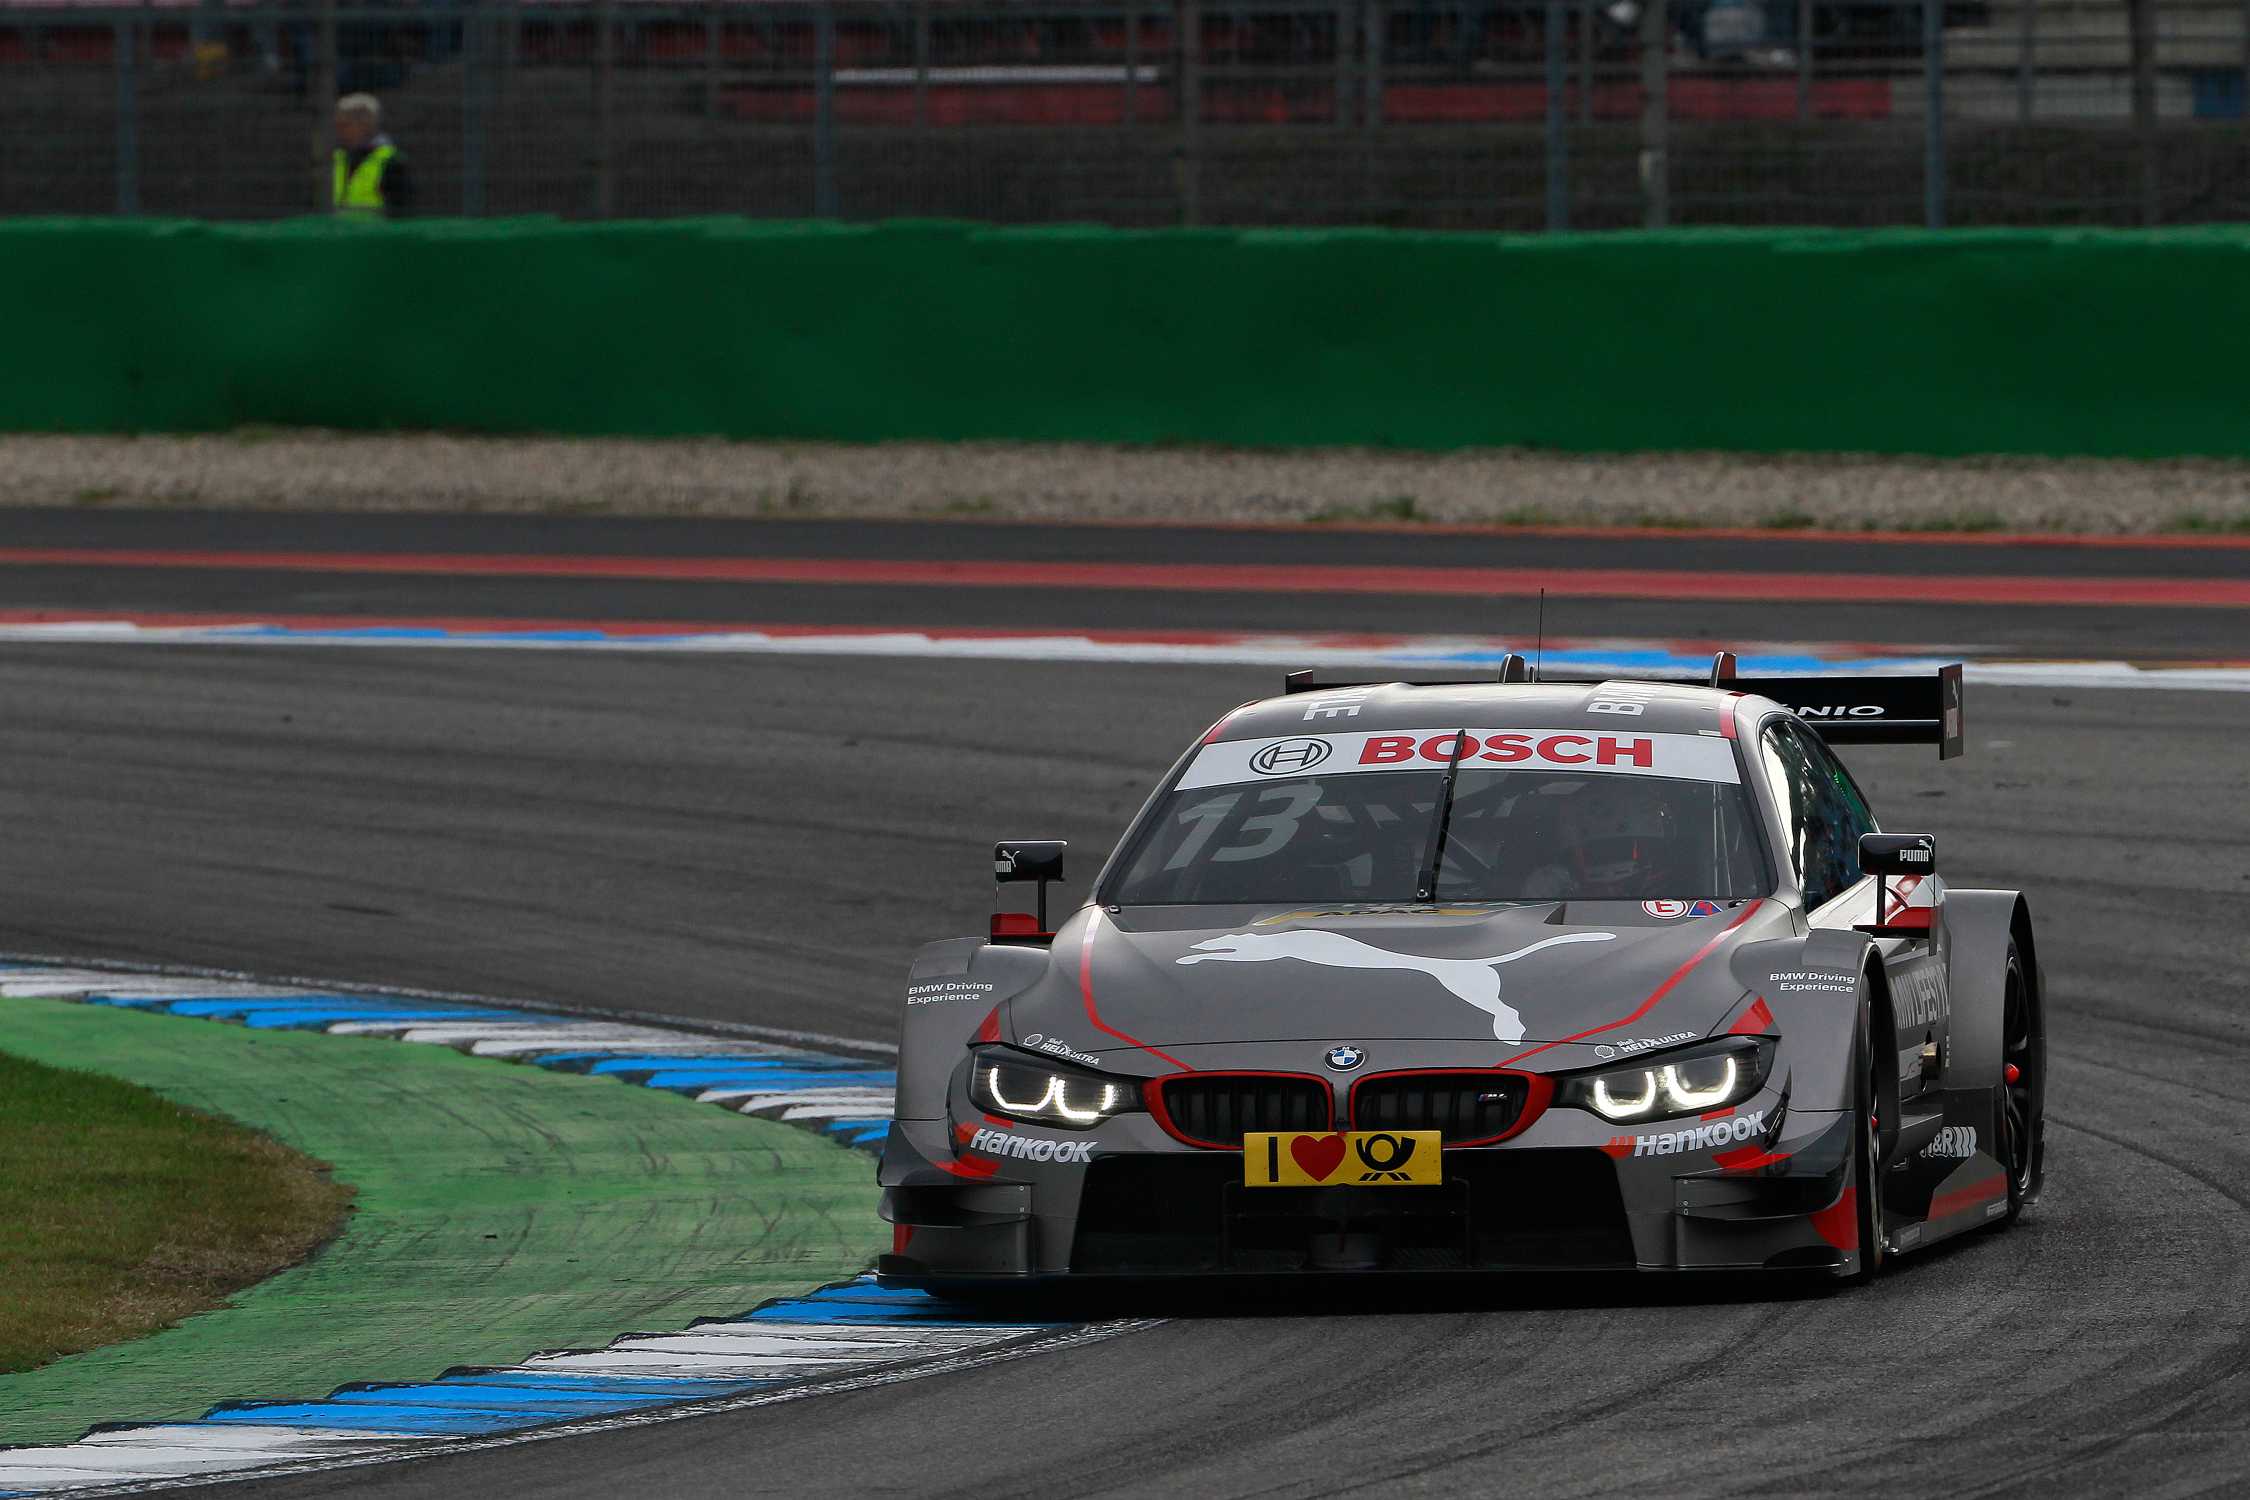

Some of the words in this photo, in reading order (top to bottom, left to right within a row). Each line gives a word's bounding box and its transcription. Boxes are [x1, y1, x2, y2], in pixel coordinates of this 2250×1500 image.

[1358, 734, 1653, 768] BOSCH
[1163, 783, 1324, 871] 13
[1899, 849, 1929, 862] PUMA
[1655, 901, 1676, 912] E
[1769, 972, 1806, 982] BMW
[1807, 972, 1856, 985] Driving
[908, 983, 944, 995] BMW
[946, 982, 993, 992] Driving
[1780, 982, 1854, 993] Experience
[907, 993, 981, 1005] Experience
[1659, 1031, 1697, 1044] ULTRA
[1070, 1051, 1100, 1065] ULTRA
[1268, 1136, 1279, 1182] I
